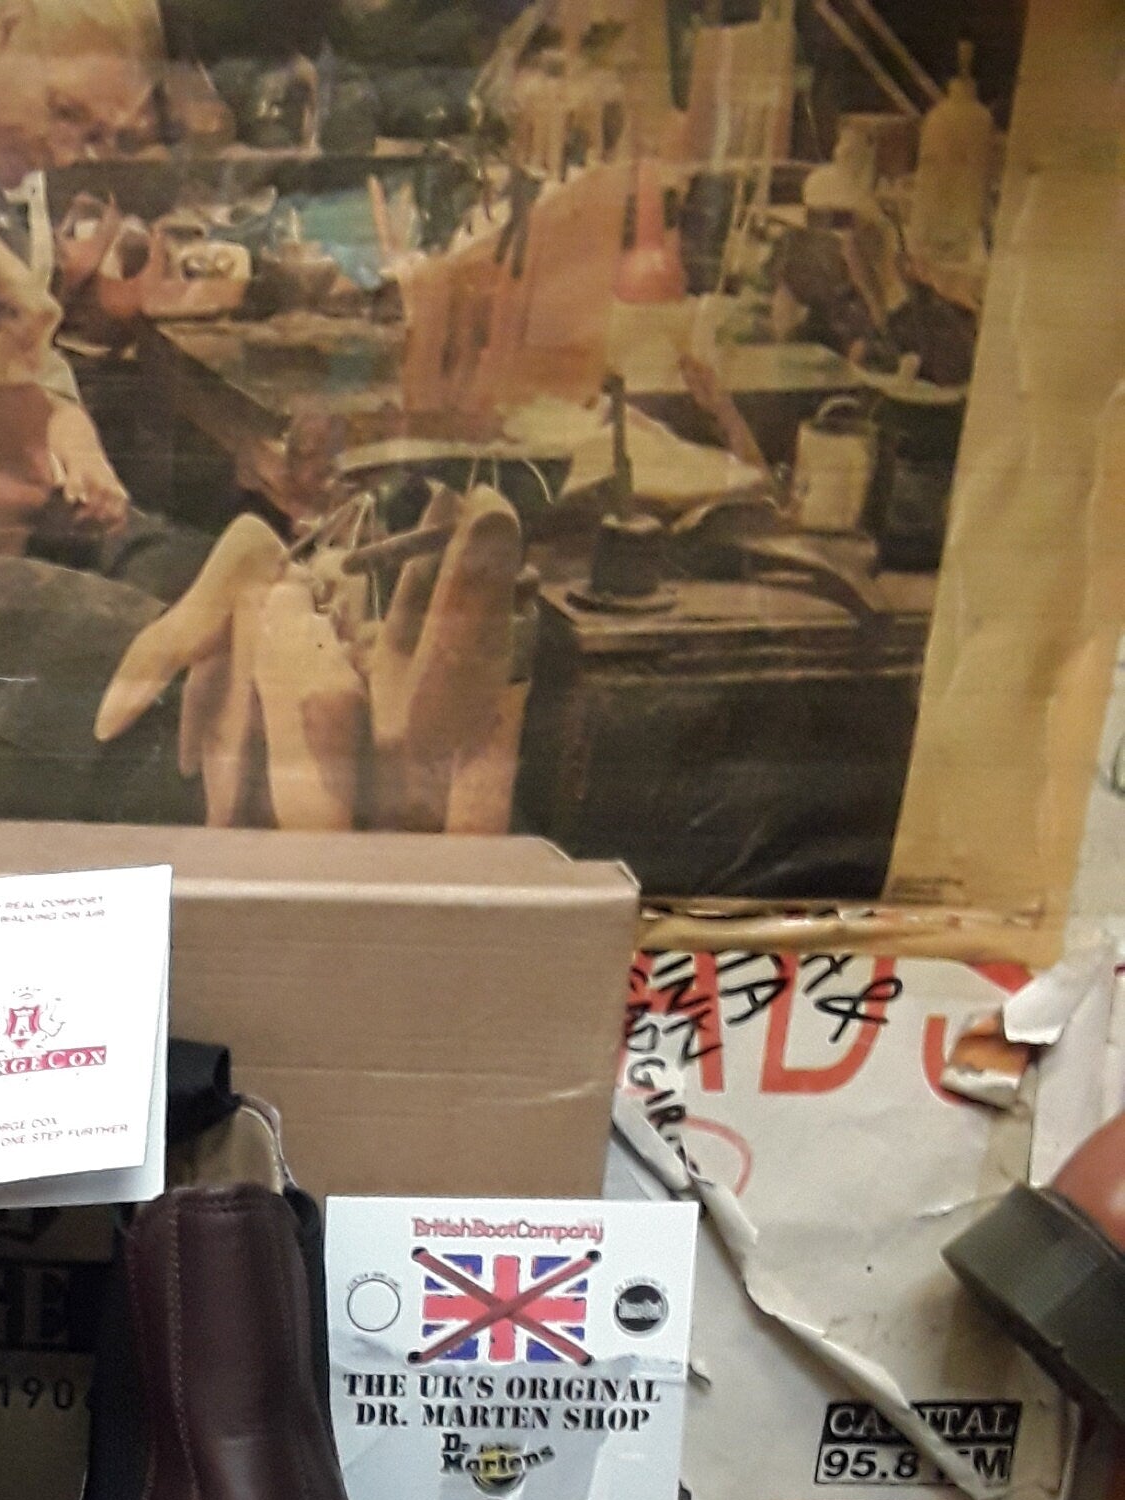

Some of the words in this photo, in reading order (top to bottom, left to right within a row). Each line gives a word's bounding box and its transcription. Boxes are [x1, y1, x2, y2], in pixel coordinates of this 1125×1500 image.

[344, 1374, 406, 1398] THE
[420, 1376, 494, 1401] UK'S
[505, 1376, 661, 1403] ORIGINAL
[356, 1402, 407, 1426] DR.
[422, 1404, 550, 1429] MARTEN
[562, 1407, 651, 1432] SHOP
